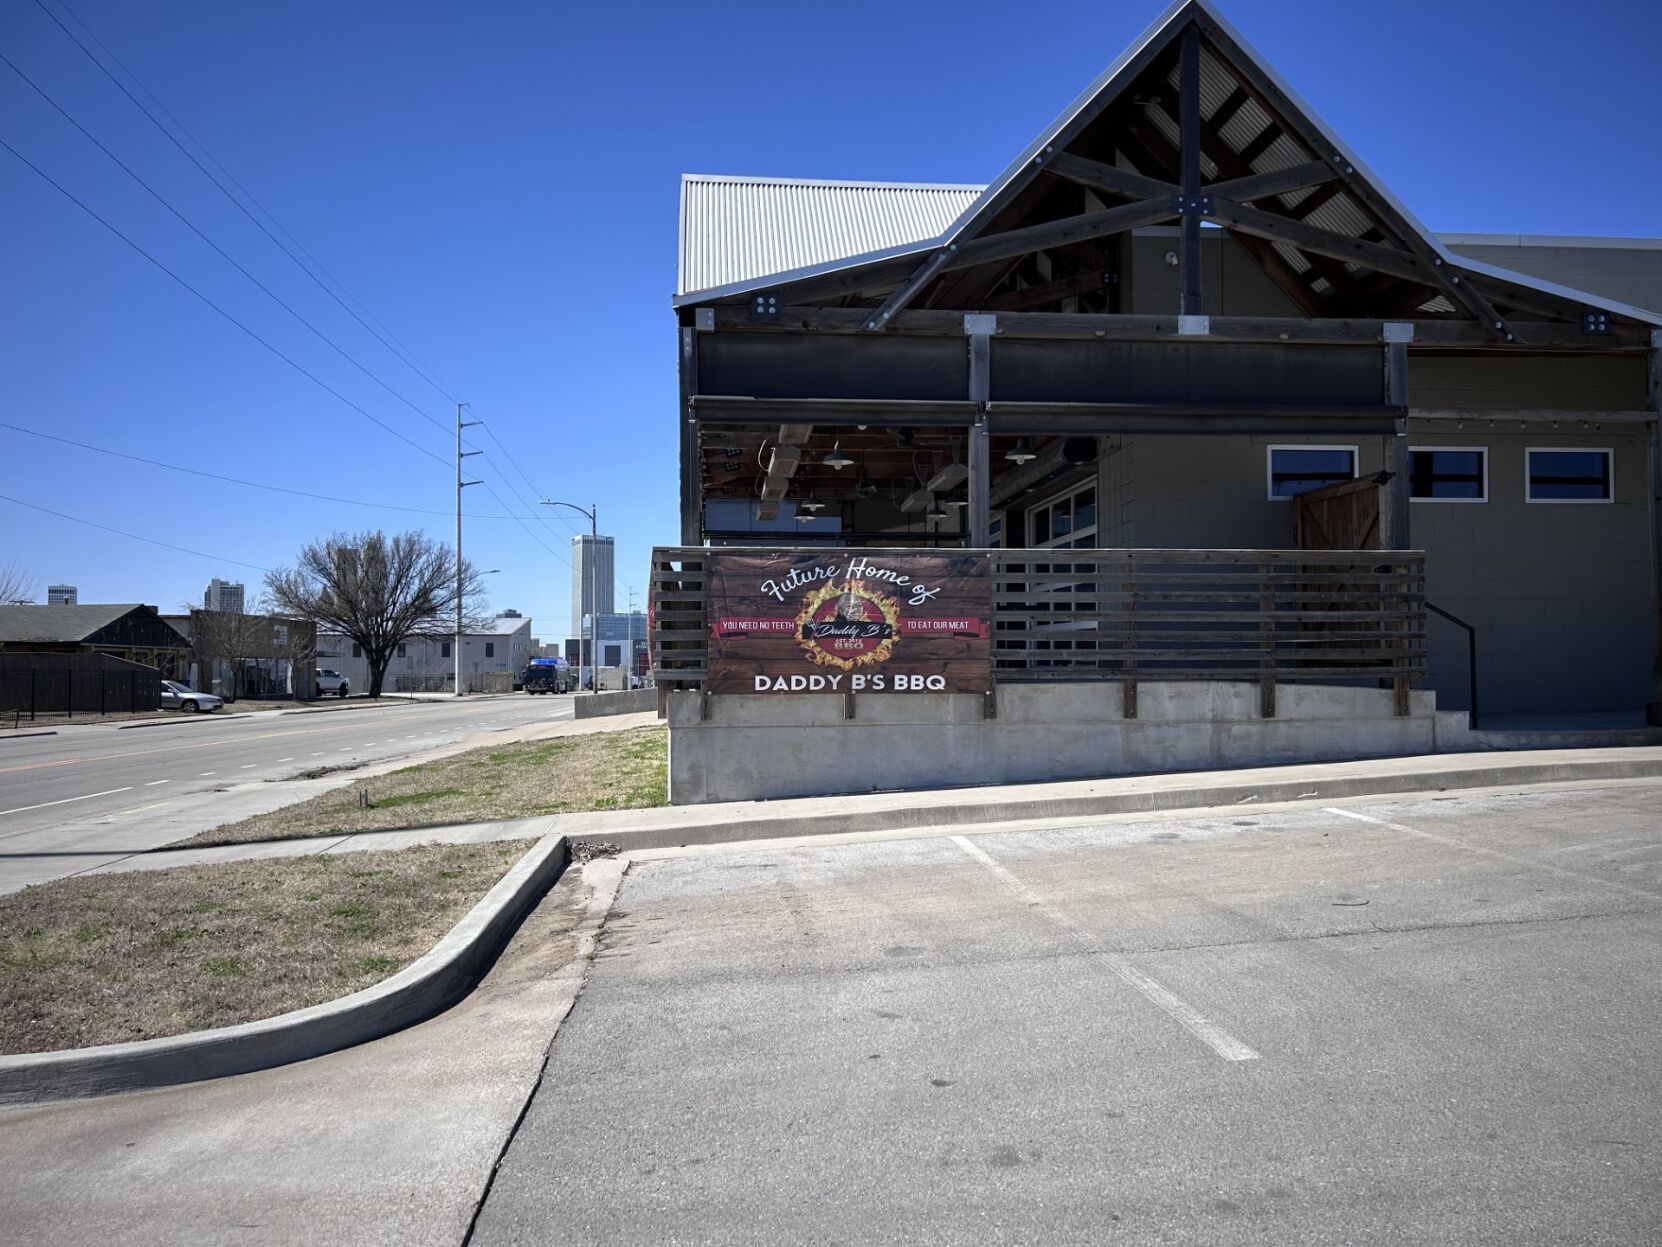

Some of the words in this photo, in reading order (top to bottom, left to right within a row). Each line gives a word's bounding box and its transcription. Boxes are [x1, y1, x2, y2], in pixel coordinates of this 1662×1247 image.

[761, 563, 841, 601] Future
[846, 557, 911, 586] Home
[908, 584, 940, 606] of
[722, 621, 738, 630] YOU
[738, 621, 758, 630] NEED
[759, 621, 770, 630] NO
[772, 621, 794, 630] TEETH
[815, 624, 860, 640] Daddy
[861, 624, 891, 637] B's
[907, 621, 917, 630] TO
[917, 621, 931, 630] EAT
[933, 621, 948, 630] OUR
[948, 621, 969, 630] MEAT
[754, 674, 845, 692] DADDY
[851, 674, 886, 691] B'S
[894, 674, 947, 691] BBQ
